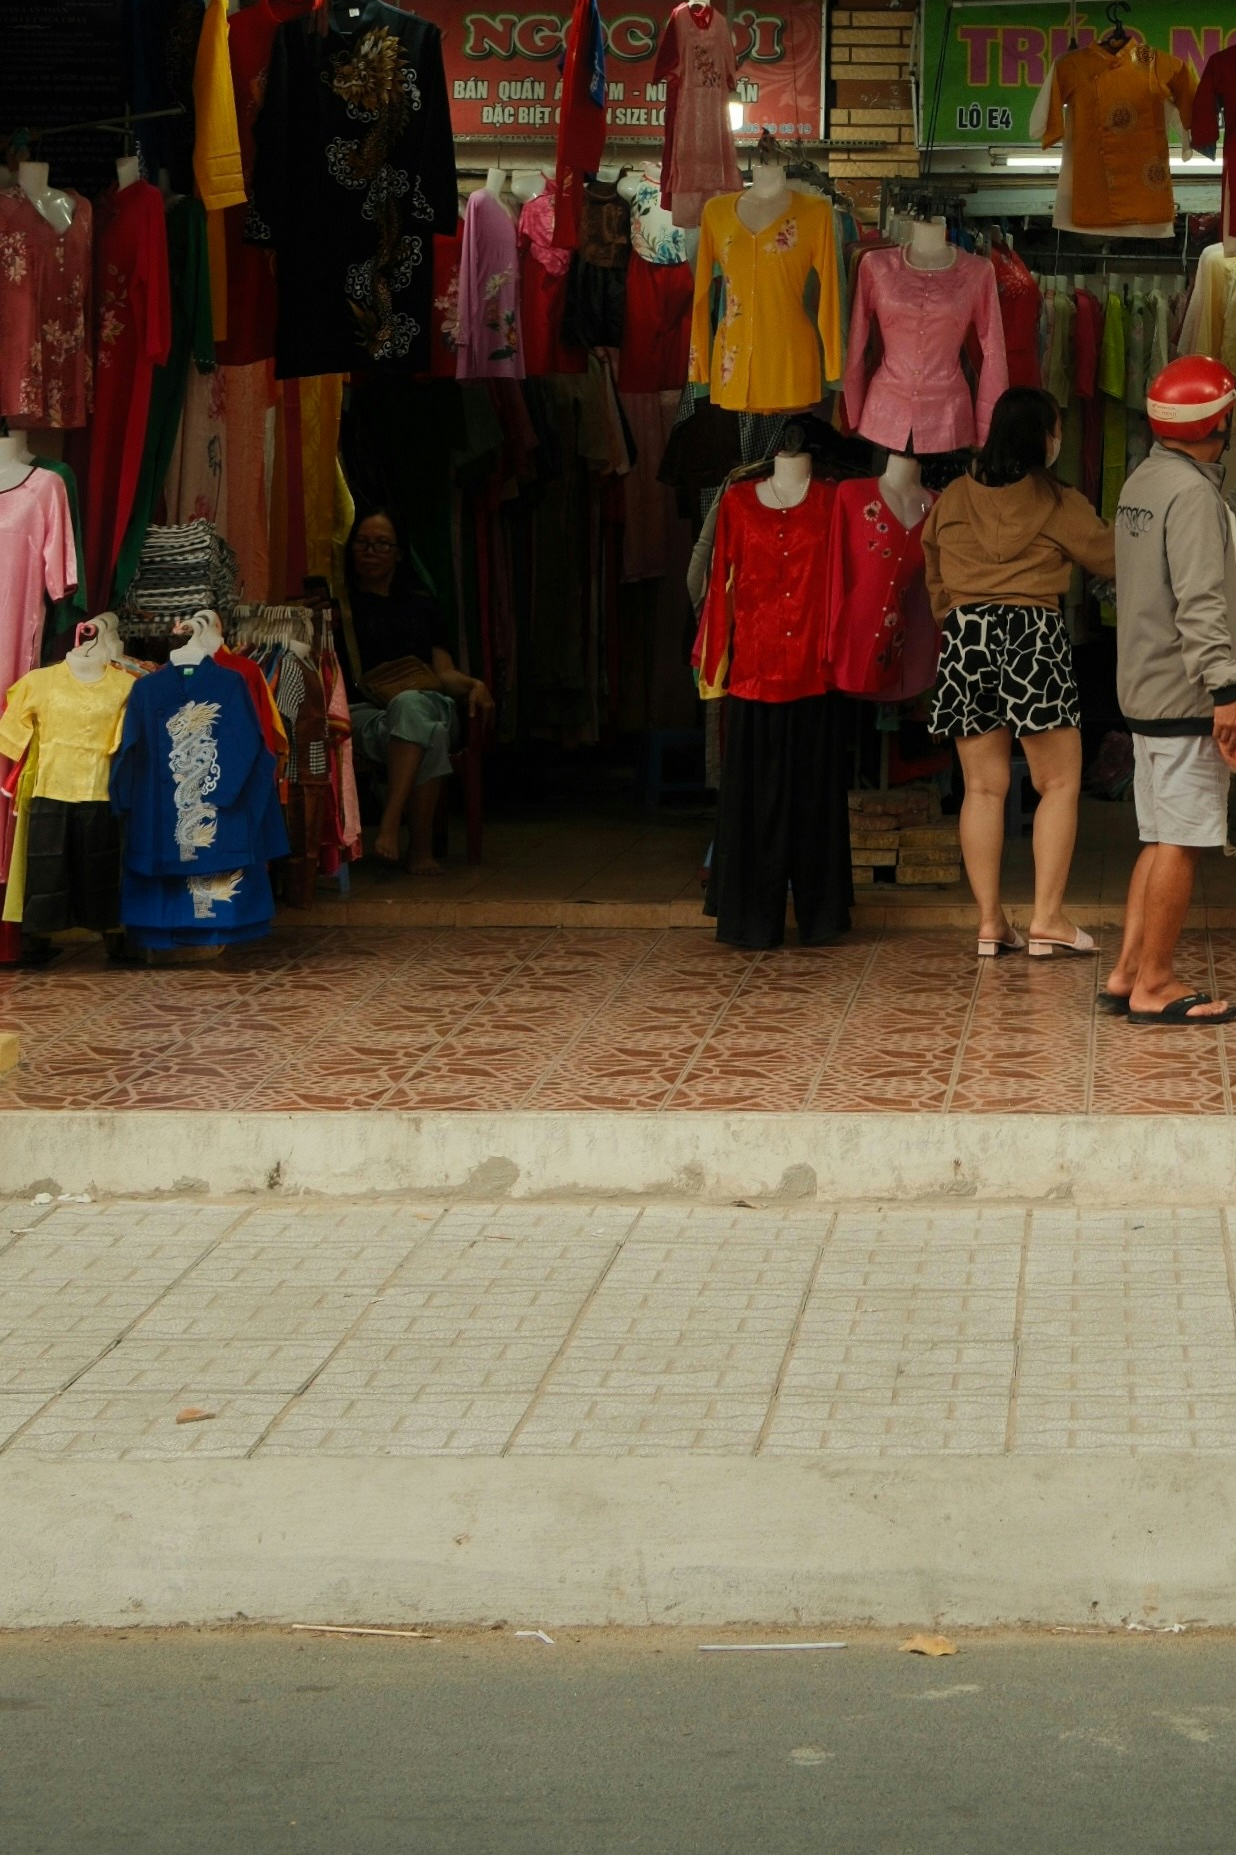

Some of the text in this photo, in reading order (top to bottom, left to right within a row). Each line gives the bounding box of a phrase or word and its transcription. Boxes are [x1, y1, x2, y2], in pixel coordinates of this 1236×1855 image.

[957, 12, 1147, 88] TRÚ
[453, 77, 489, 100] BÁN
[497, 76, 546, 102] QUẦN
[482, 102, 515, 127] ĐẶC
[517, 104, 551, 128] BIỆT
[615, 107, 648, 126] SIZE
[957, 101, 1012, 130] LÔ E4
